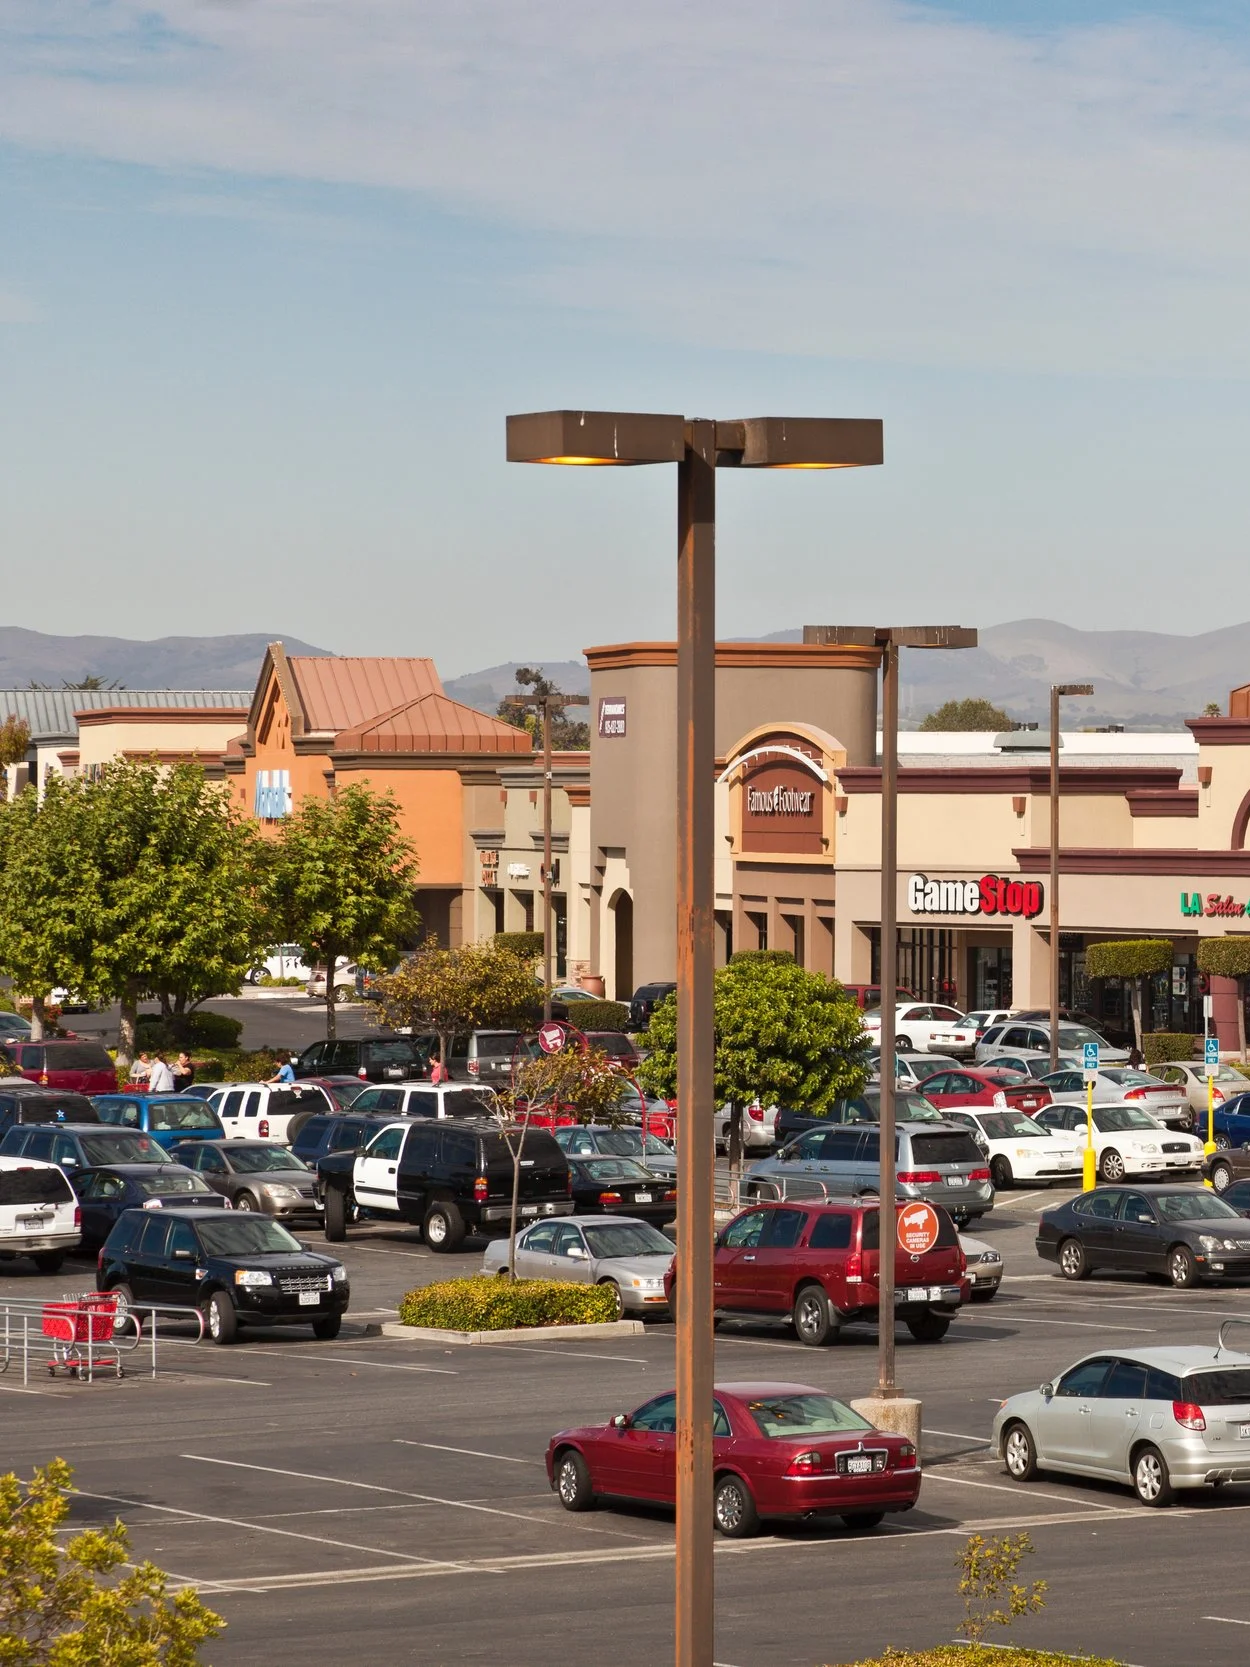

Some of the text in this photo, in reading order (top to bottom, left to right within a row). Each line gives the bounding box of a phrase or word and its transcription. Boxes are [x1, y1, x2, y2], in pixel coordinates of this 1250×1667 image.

[747, 786, 812, 812] Famous Footwear
[908, 874, 1041, 917] GameStop
[1181, 892, 1200, 914] LA
[1204, 894, 1243, 915] Salon
